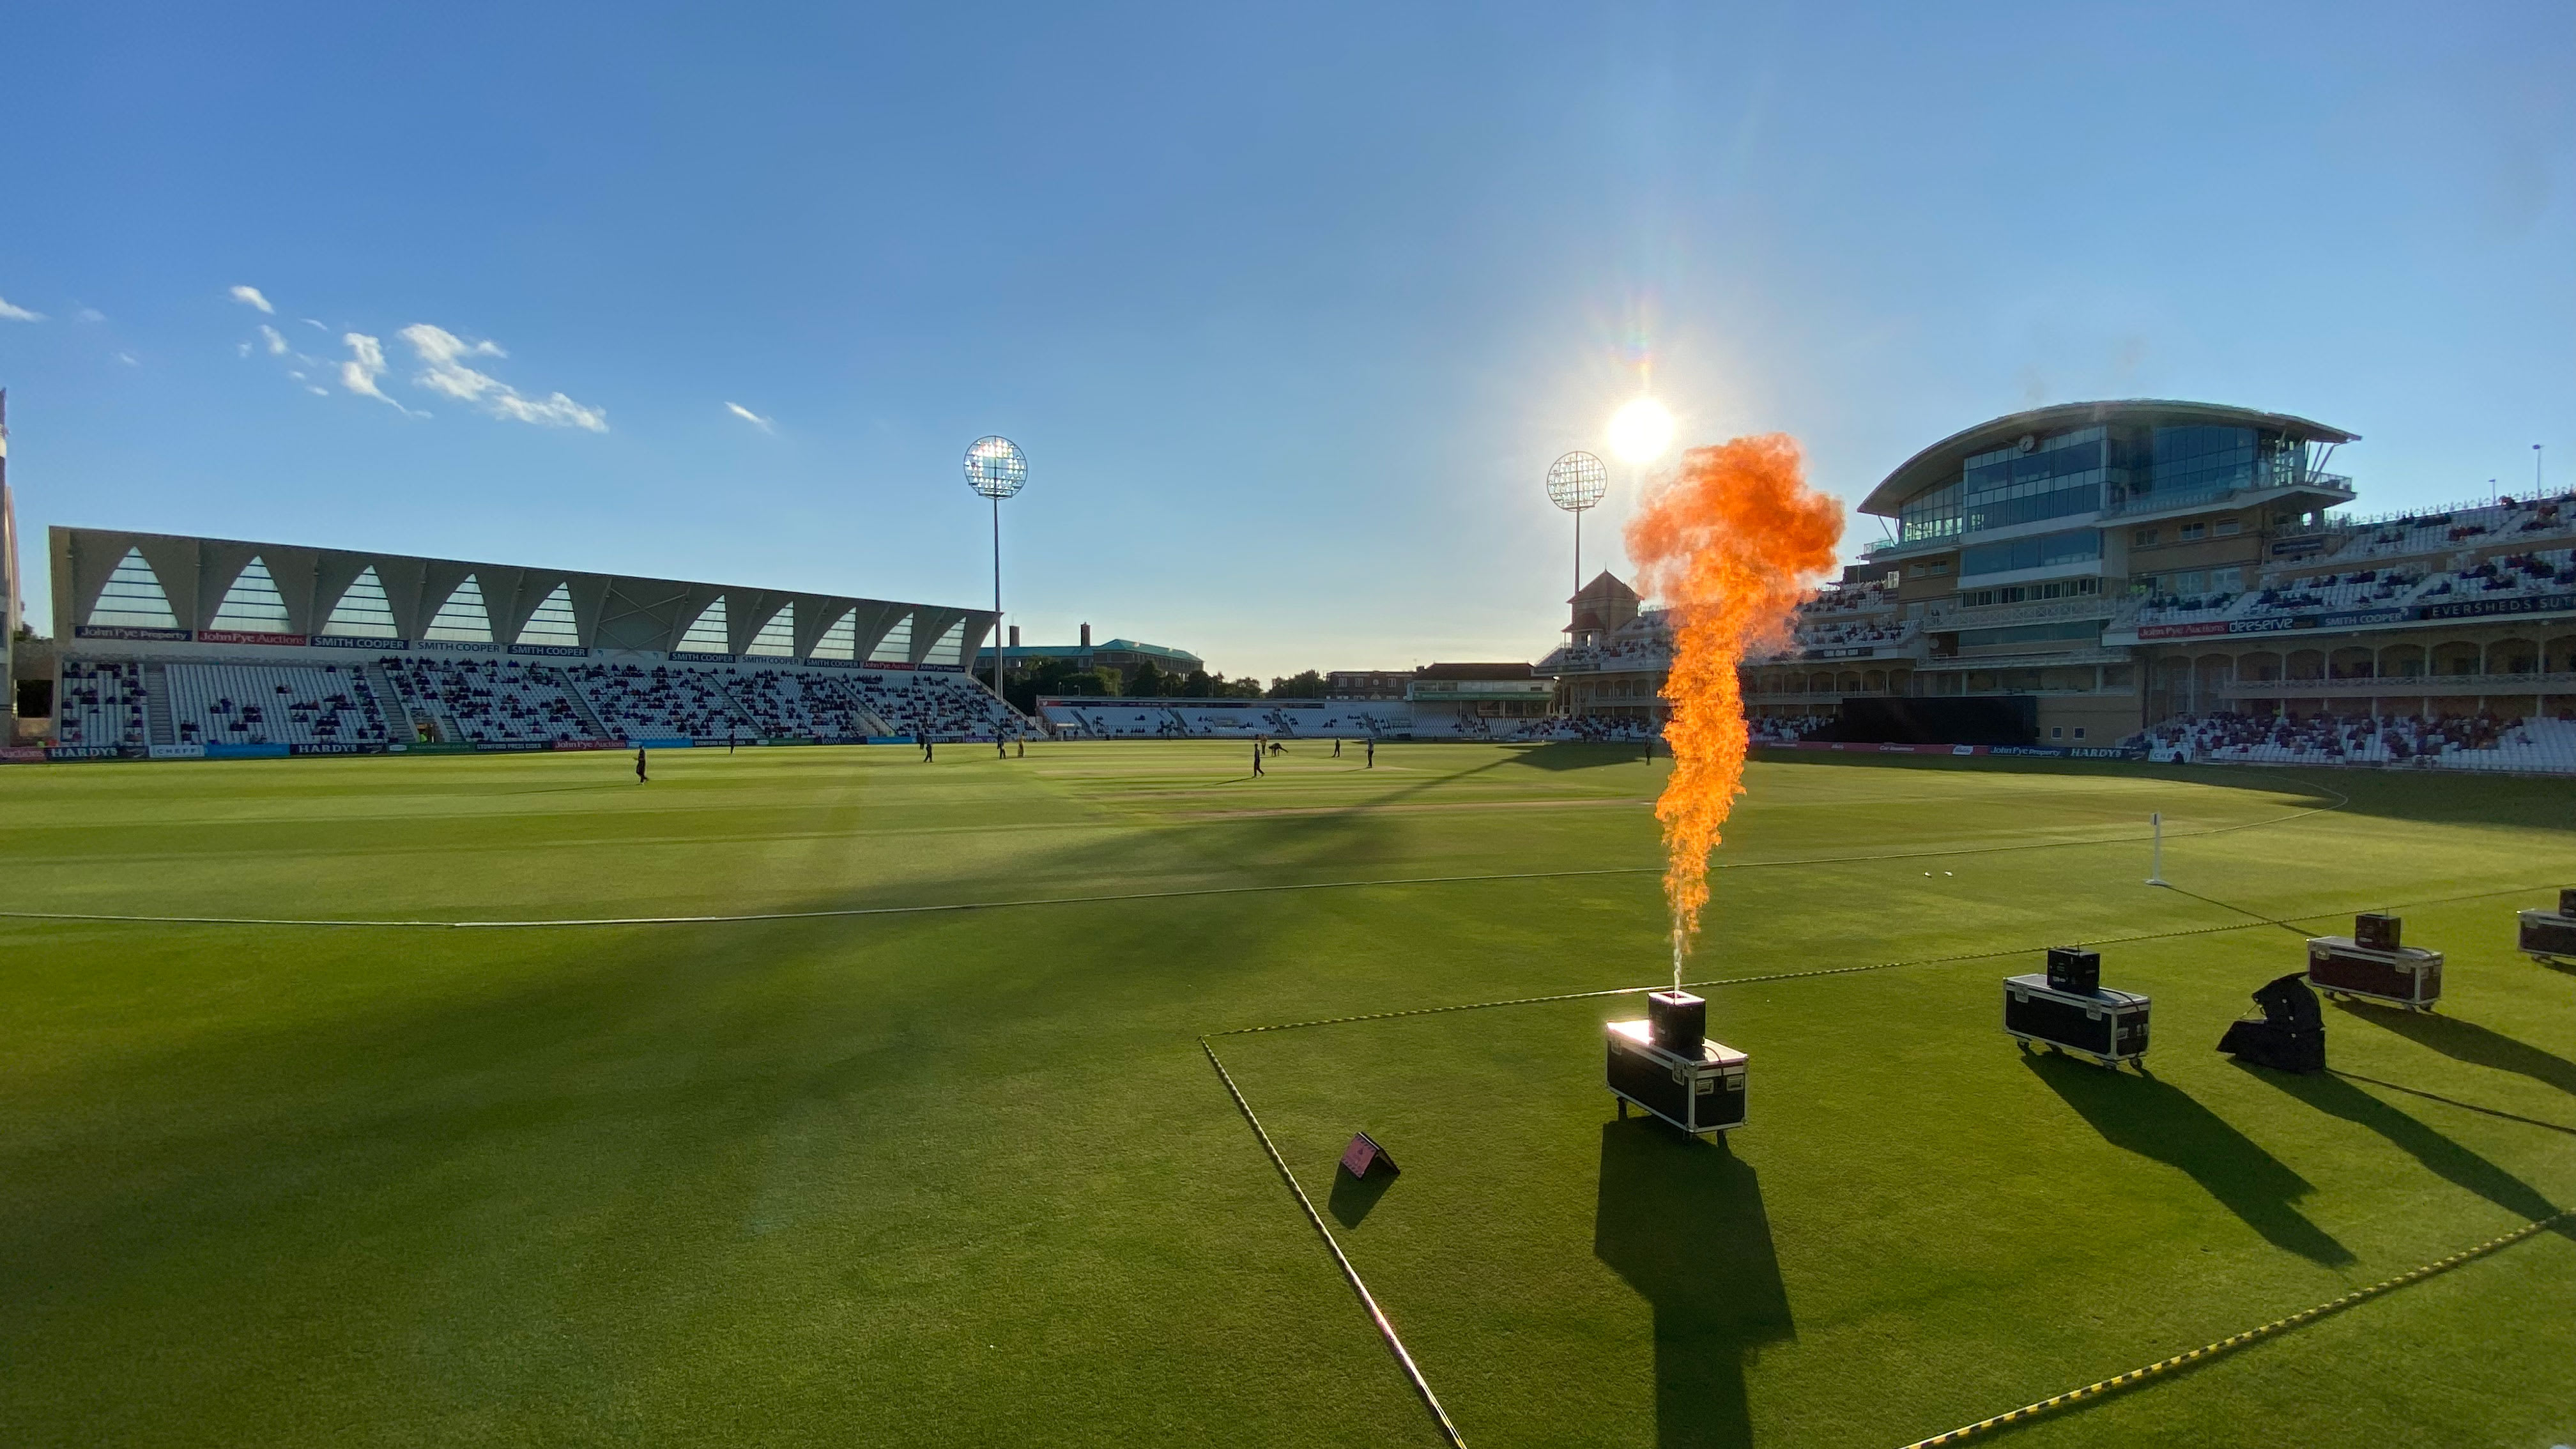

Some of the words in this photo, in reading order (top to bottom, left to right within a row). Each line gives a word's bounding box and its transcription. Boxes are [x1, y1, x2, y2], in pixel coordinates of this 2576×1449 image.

[2432, 599, 2532, 617] EVERSHEDS
[2325, 616, 2357, 627] SMITH
[2359, 611, 2402, 624] COOPER
[2229, 617, 2294, 633] deeserve
[81, 627, 113, 637] John
[116, 629, 139, 640] Pye
[141, 630, 188, 640] Property
[2140, 627, 2164, 638] John
[2186, 624, 2225, 634] Auctions
[201, 632, 231, 642] John
[233, 633, 255, 644] Pye
[256, 634, 304, 645] Auctions
[315, 637, 353, 647] SMITH
[356, 639, 404, 649] COOPER
[418, 641, 453, 650] SMITH
[456, 643, 500, 652] COOPER
[512, 645, 544, 655] SMITH
[546, 647, 586, 656] COOPER
[831, 660, 859, 668] COOPER
[298, 744, 357, 753] HARDYS
[577, 741, 592, 750] Pye
[52, 747, 118, 758] HARDYS
[2013, 747, 2027, 756] Pye
[2071, 748, 2122, 758] HARDYS
